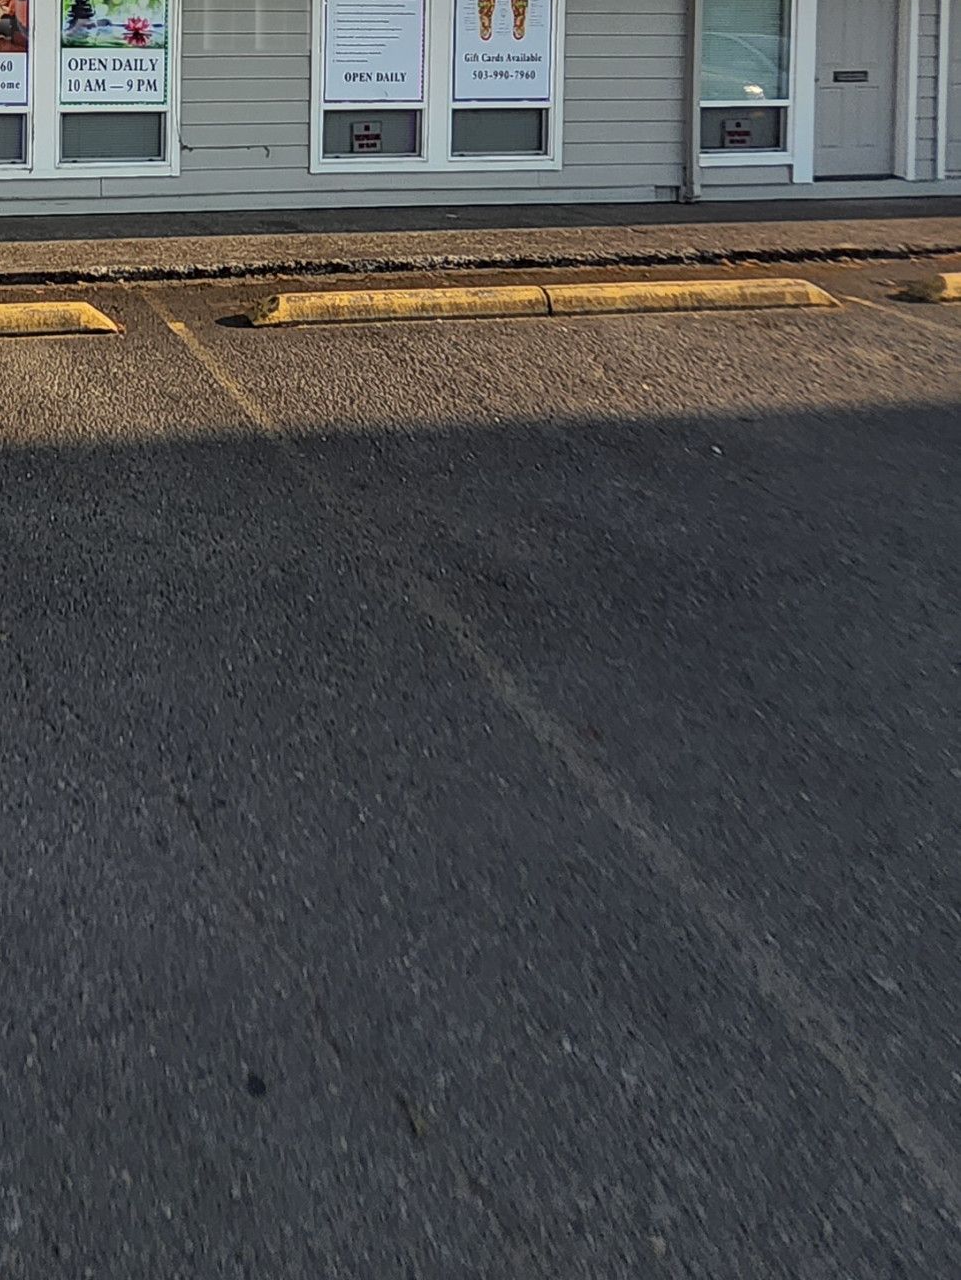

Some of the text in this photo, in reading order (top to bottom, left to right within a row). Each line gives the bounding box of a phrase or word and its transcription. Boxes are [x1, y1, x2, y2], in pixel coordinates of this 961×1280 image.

[464, 53, 542, 63] Gift Cards Available
[68, 57, 159, 72] OPEN DAILY
[344, 72, 407, 83] OPEN DAILY
[472, 70, 536, 80] 503-990-7960
[67, 79, 81, 92] 10
[83, 79, 107, 92] AM
[126, 79, 134, 92] 9
[137, 79, 158, 92] PM
